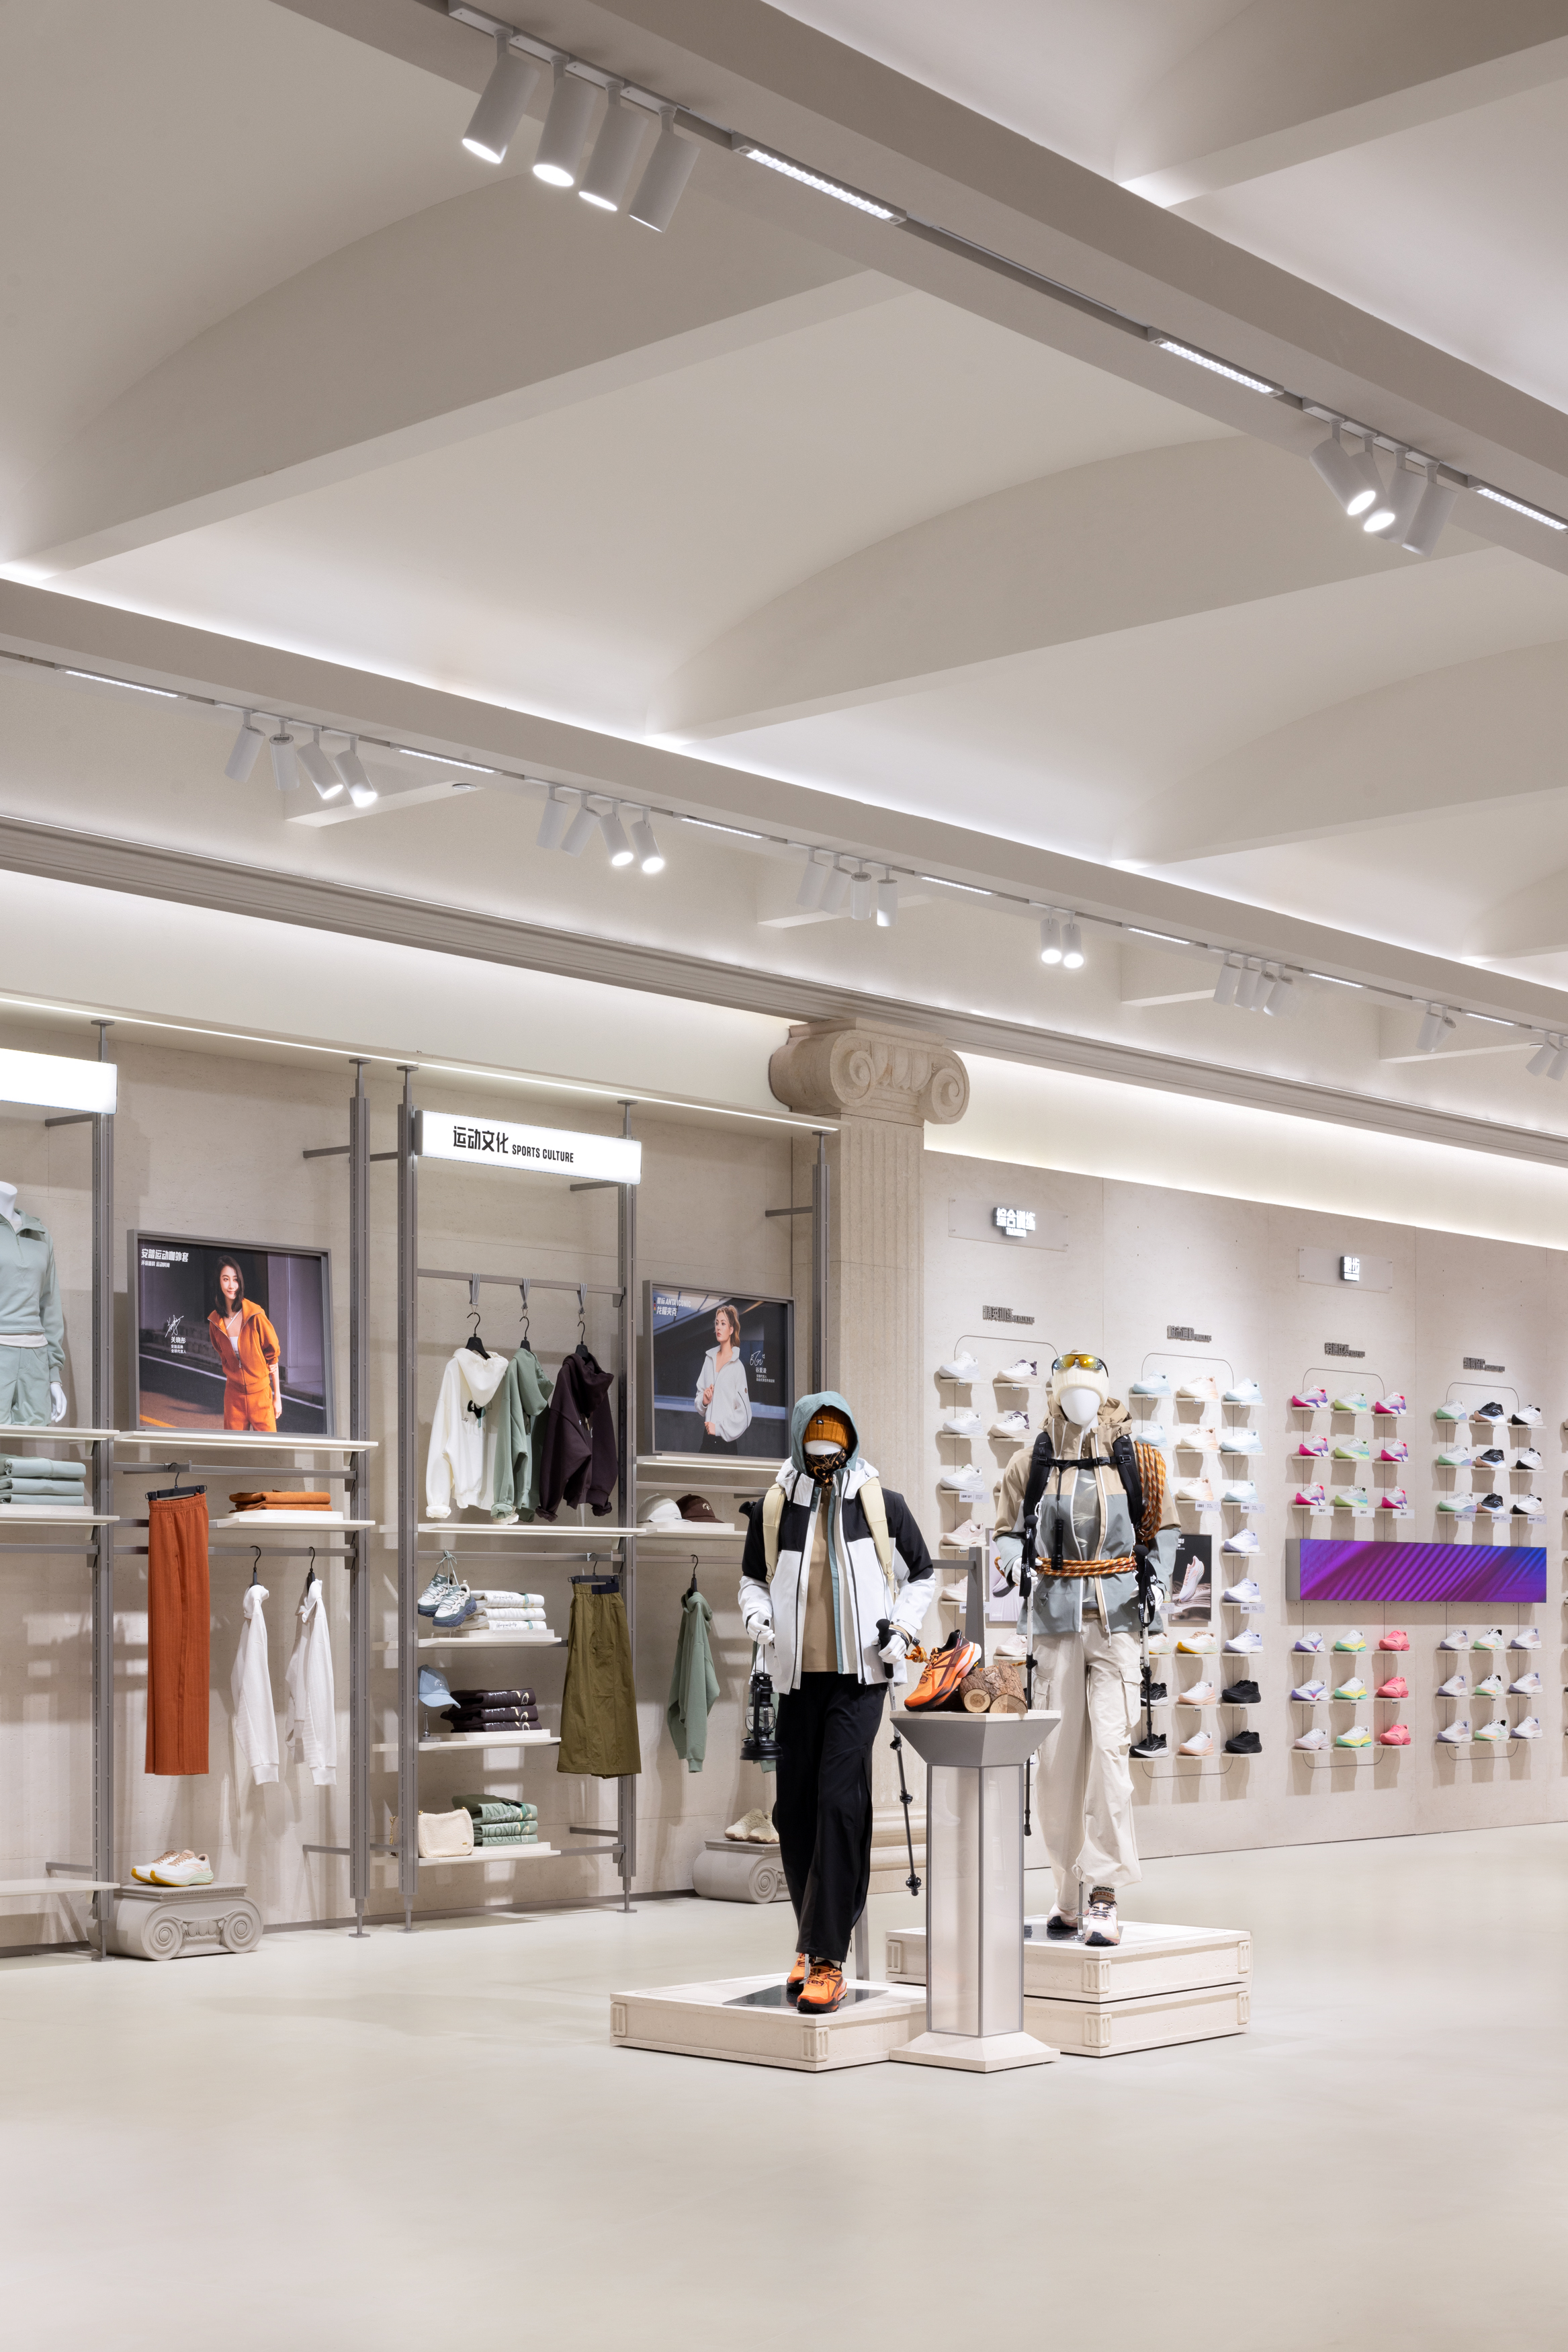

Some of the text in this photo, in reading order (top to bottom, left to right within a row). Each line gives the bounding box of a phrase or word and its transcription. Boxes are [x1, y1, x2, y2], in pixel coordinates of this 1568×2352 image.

[453, 1126, 574, 1163] 运动文化 SPORTS CULTURE
[996, 1207, 1036, 1231] 综合训练
[140, 1248, 189, 1263] 安踏运动咖外套
[665, 1298, 677, 1306] ANTA
[677, 1299, 691, 1308] ICONIC
[983, 1305, 1013, 1322] 精英训练
[171, 1336, 186, 1344] 关晓彤
[485, 1804, 515, 1818] ANTA
